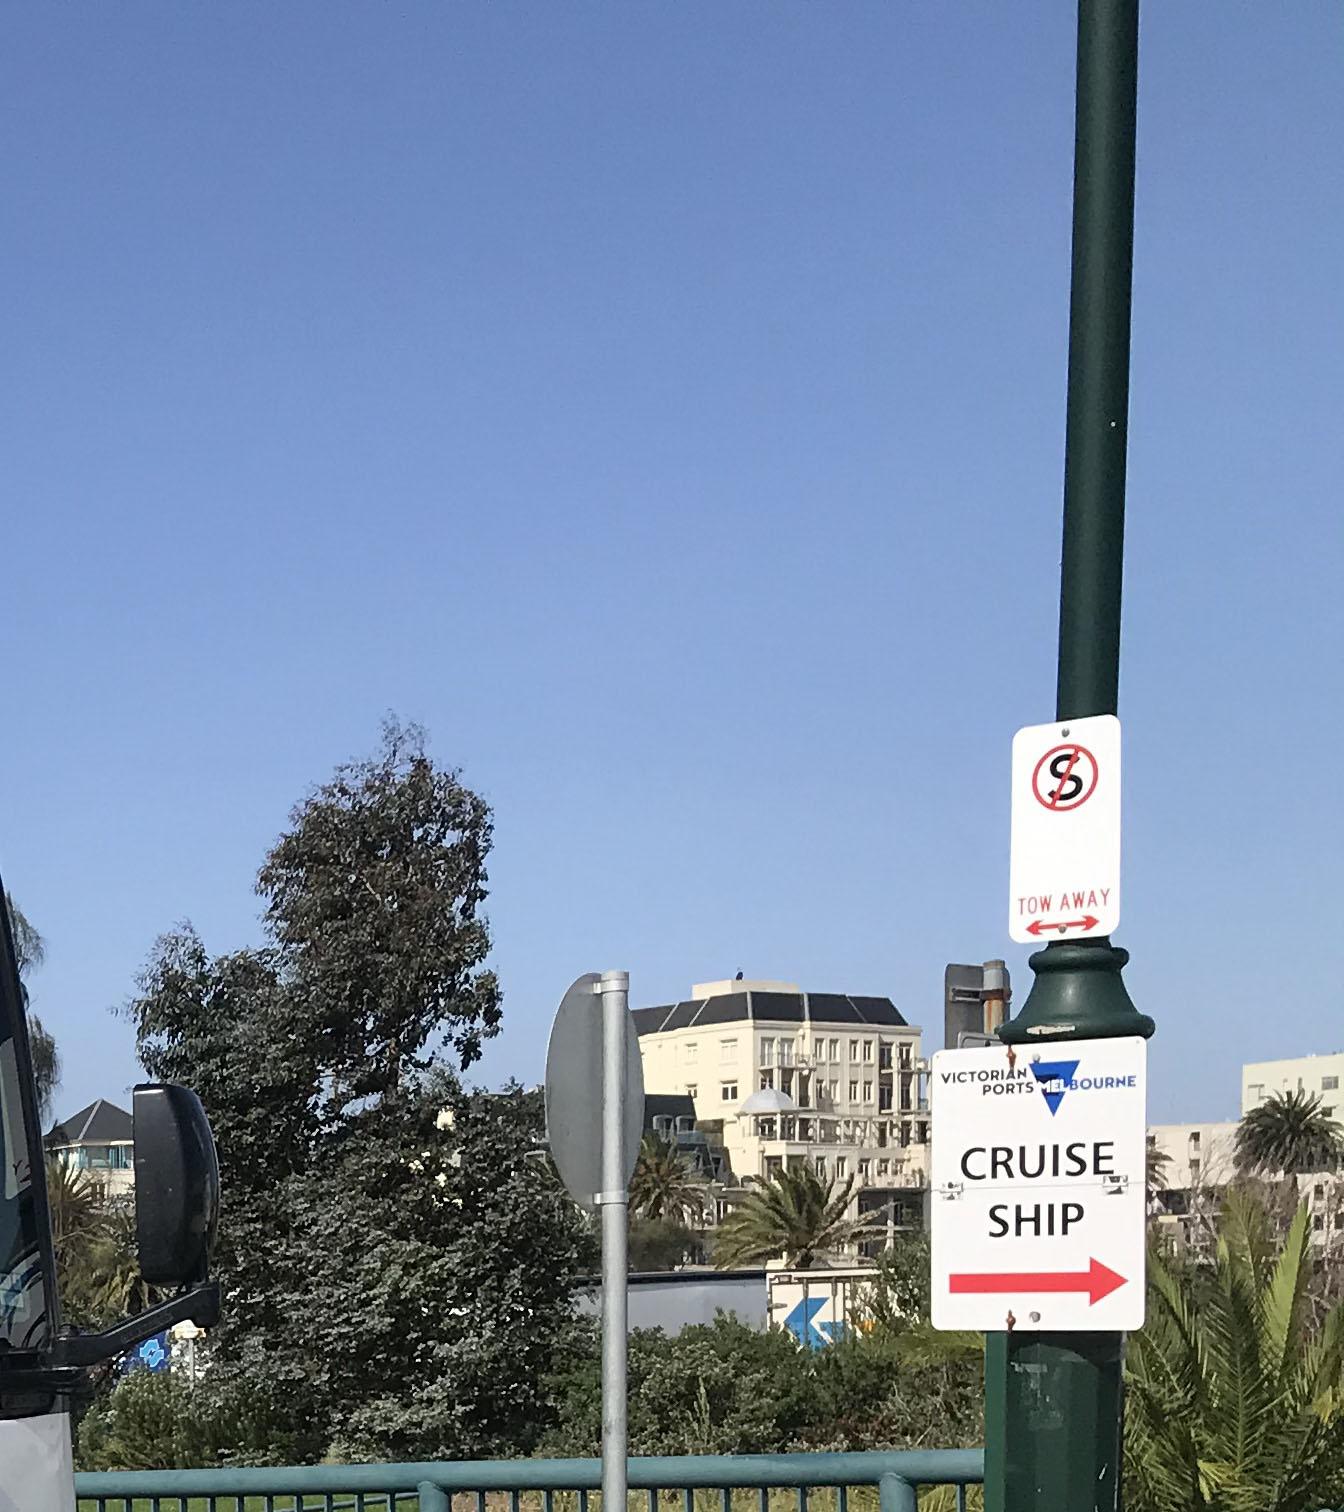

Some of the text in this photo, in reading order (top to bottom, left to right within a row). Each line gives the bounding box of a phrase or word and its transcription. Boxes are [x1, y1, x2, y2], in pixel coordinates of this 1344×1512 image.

[1018, 888, 1111, 915] TOW AWAY
[941, 1067, 1028, 1084] VICTORIAN
[982, 1075, 1137, 1096] PORTS MELBOURNE
[961, 1141, 1115, 1181] CRUISE
[988, 1203, 1085, 1238] SHIP
